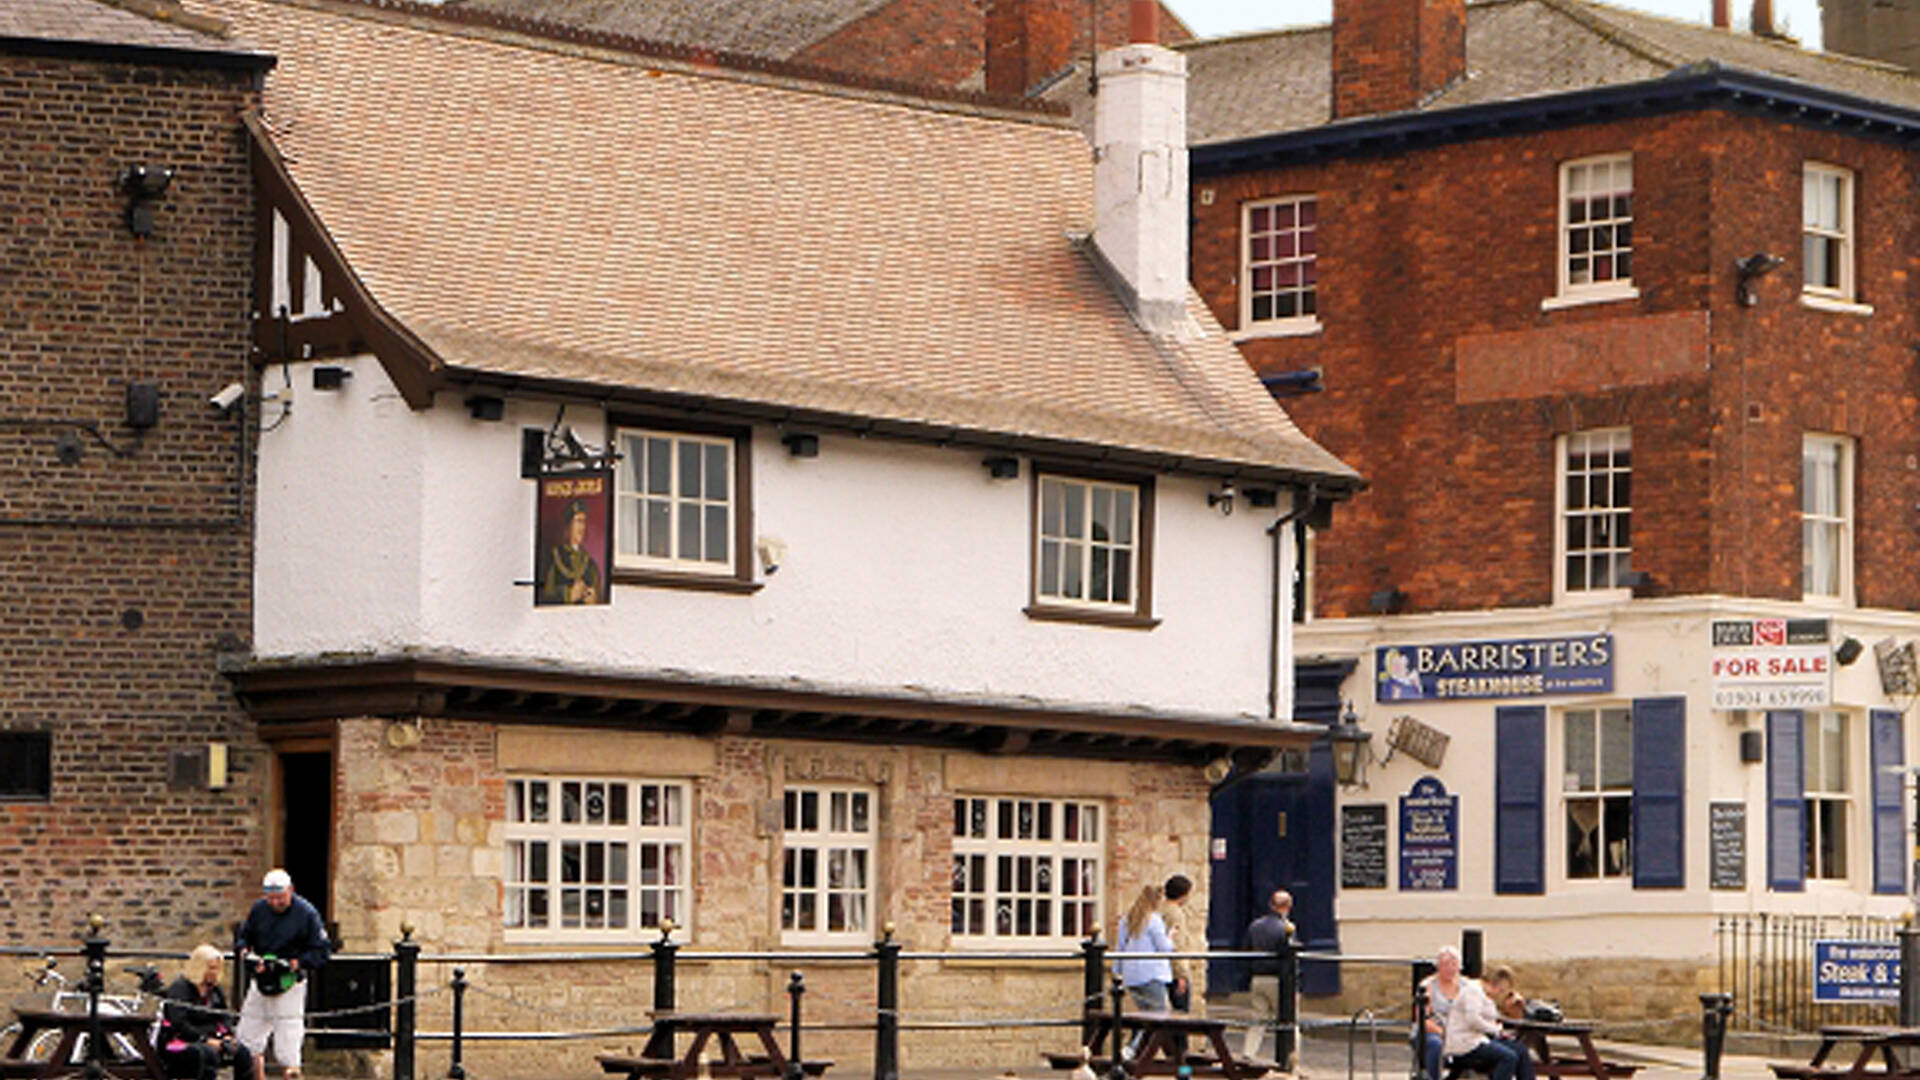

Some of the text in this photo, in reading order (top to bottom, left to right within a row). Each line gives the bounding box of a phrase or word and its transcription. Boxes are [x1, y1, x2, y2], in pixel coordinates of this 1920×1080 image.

[1417, 637, 1609, 673] BARRISTERS
[1712, 657, 1828, 676] FOR SALE
[1437, 674, 1544, 697] STEAKHOUSE
[1820, 961, 1869, 983] Steak
[1873, 962, 1888, 983] &
